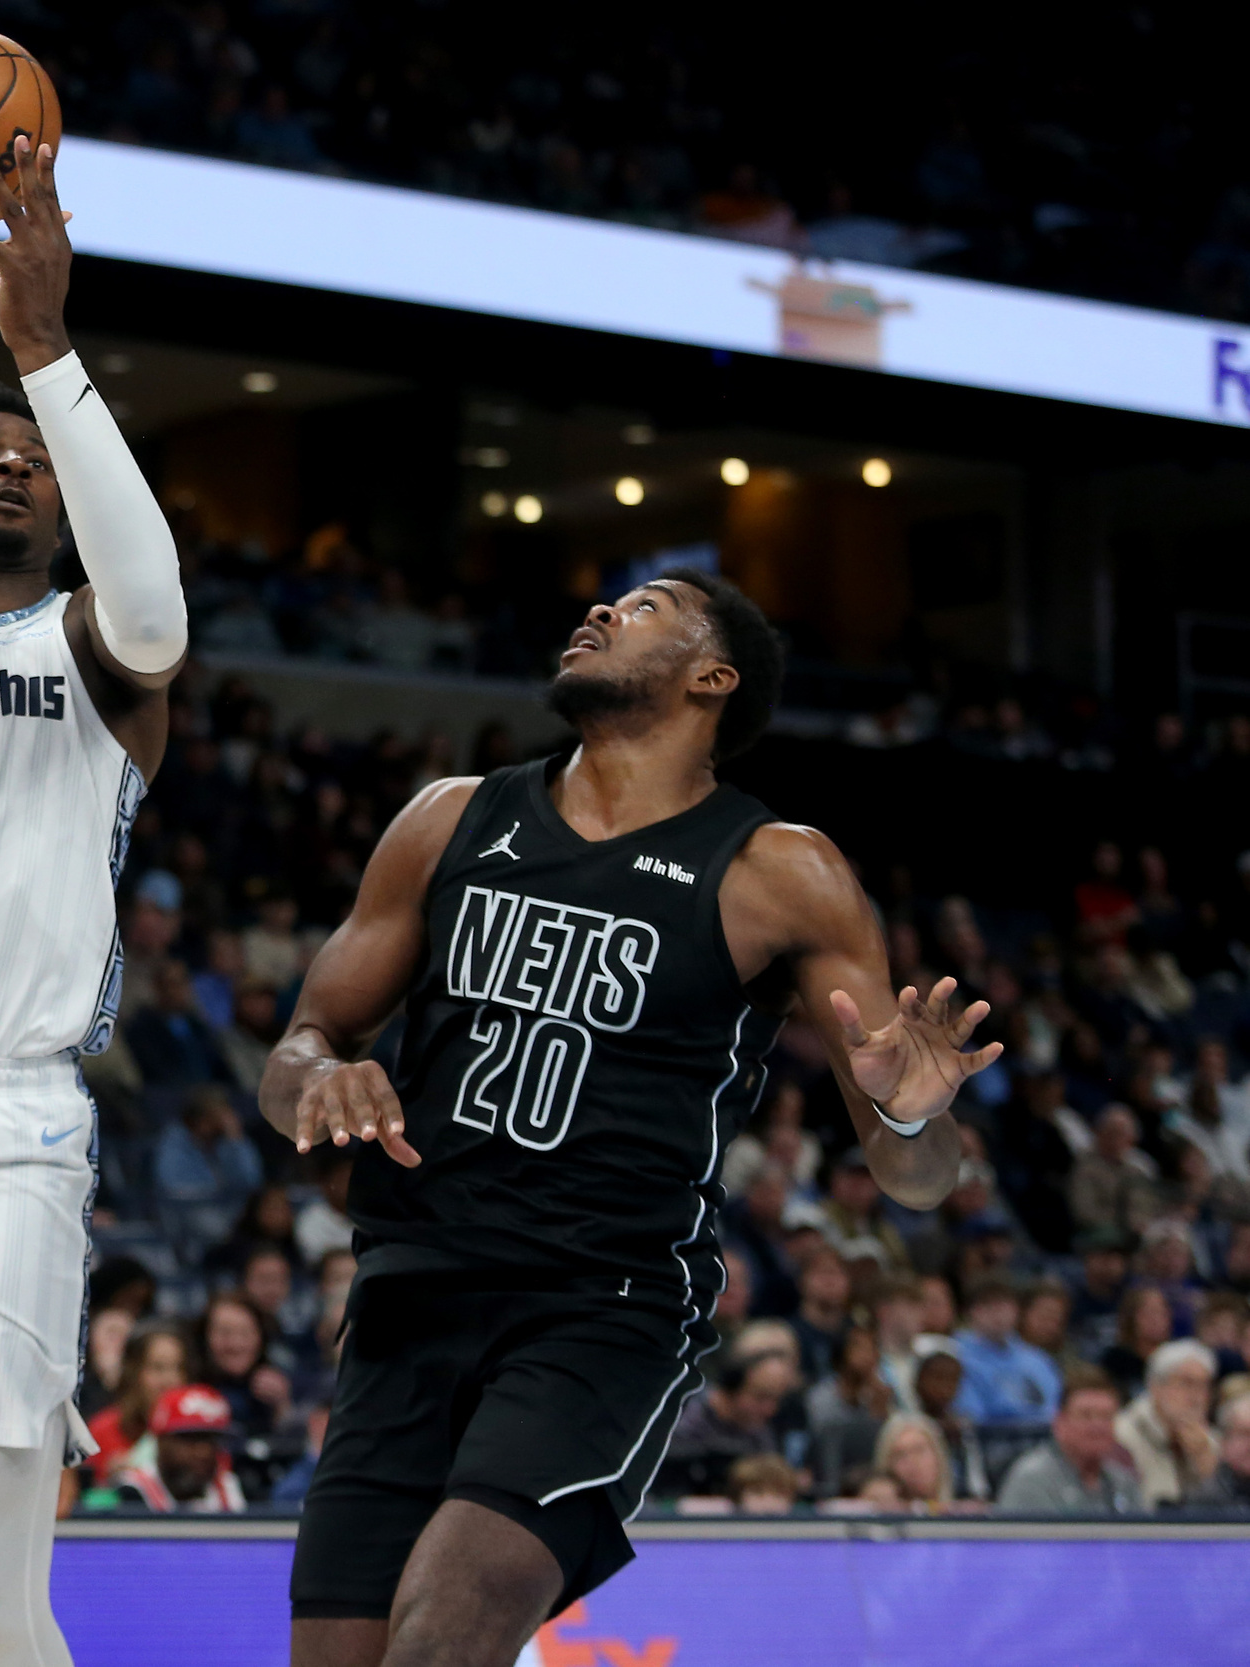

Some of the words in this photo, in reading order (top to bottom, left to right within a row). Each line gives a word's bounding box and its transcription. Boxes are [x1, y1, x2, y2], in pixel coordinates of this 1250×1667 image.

[633, 854, 654, 872] All
[652, 857, 667, 876] In
[667, 861, 695, 885] Won
[447, 885, 661, 1033] NETS
[452, 1004, 593, 1151] 20
